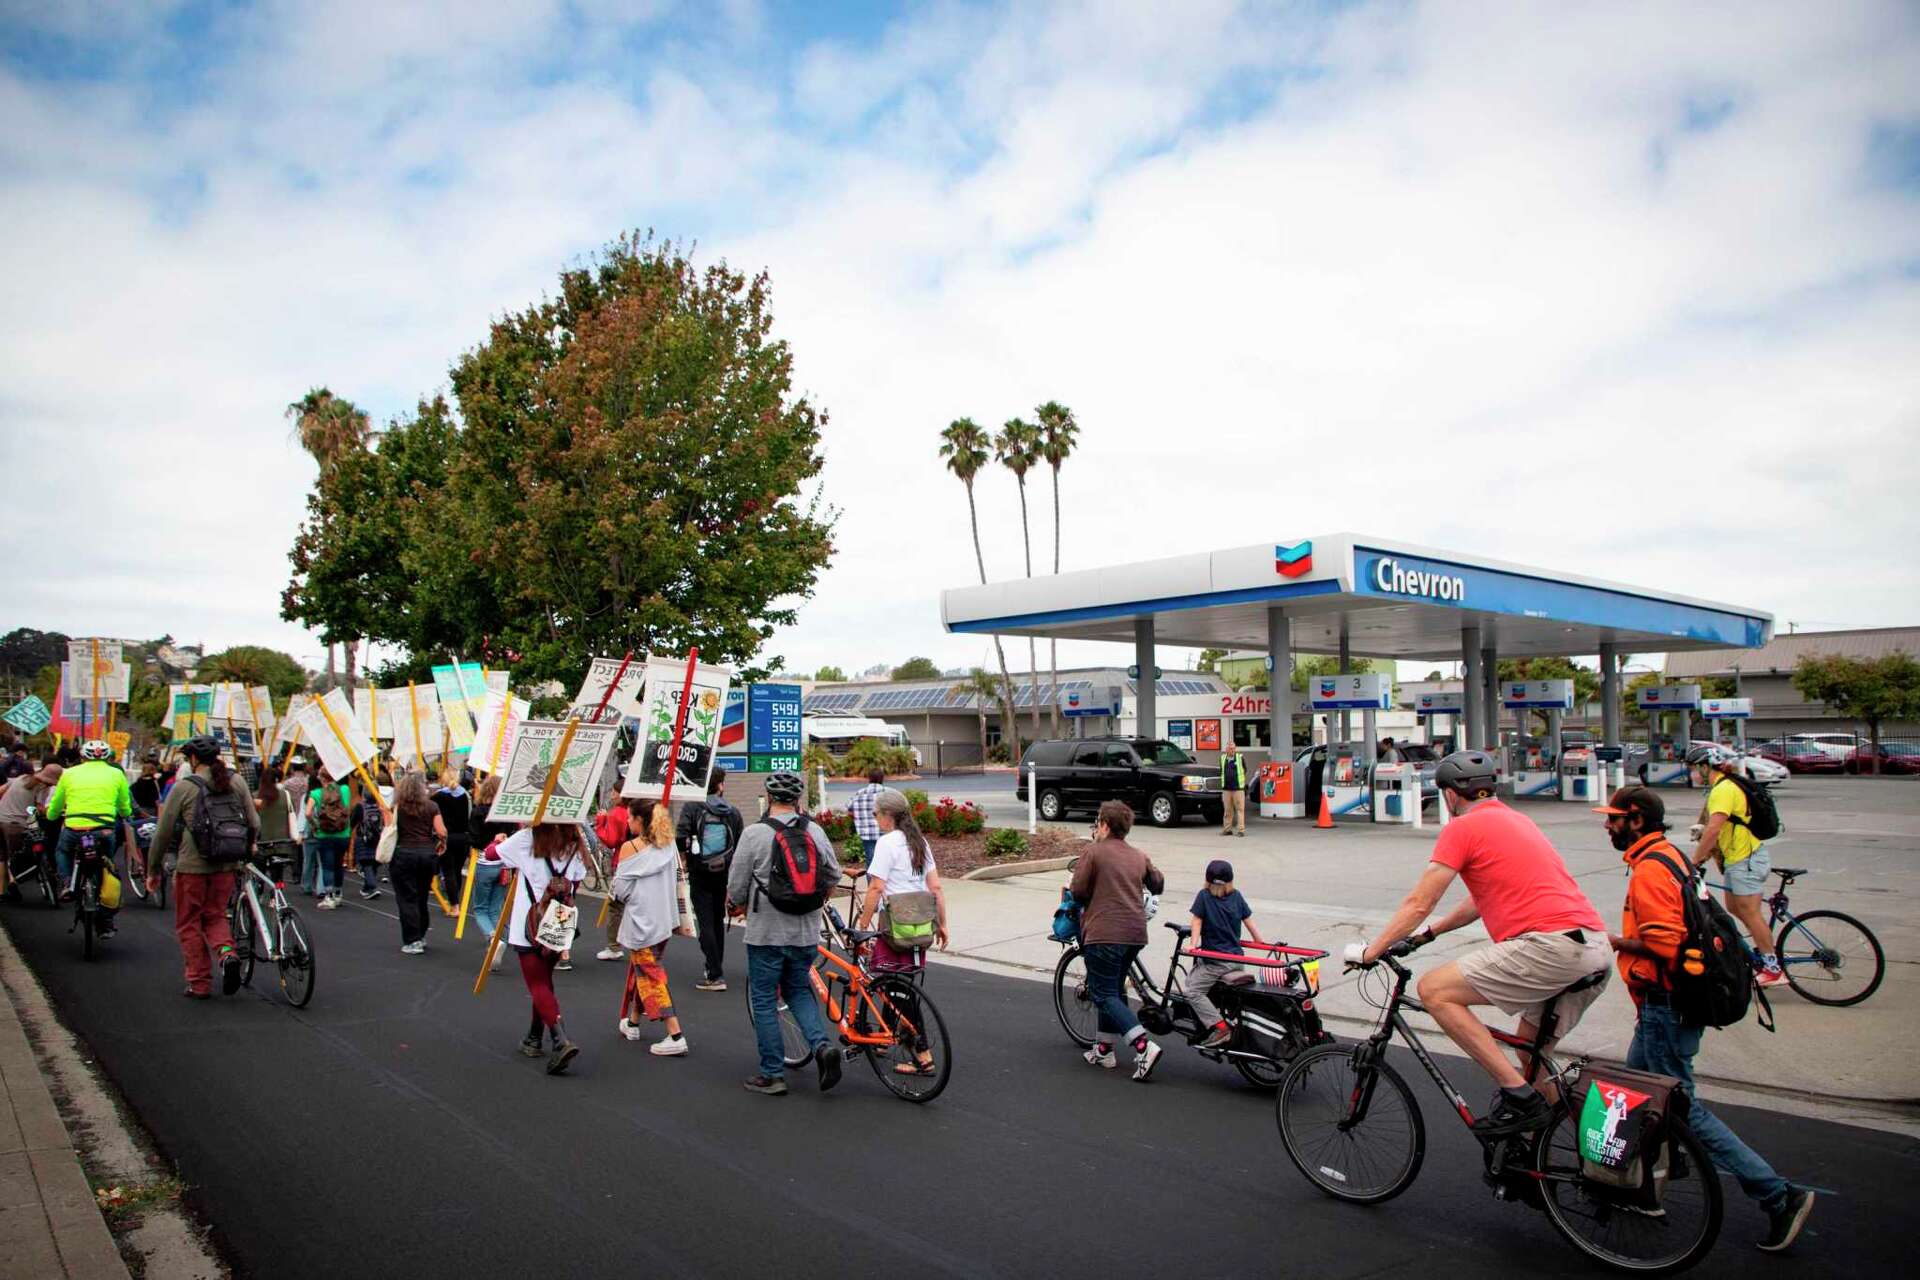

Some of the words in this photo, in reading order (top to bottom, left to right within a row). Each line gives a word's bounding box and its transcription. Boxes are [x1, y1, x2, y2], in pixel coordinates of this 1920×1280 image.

[1377, 556, 1464, 601] Chevron
[1353, 678, 1361, 690] 3
[1541, 683, 1549, 692] 5
[1672, 689, 1680, 697] 7
[1222, 697, 1272, 713] 24hrs
[1586, 1137, 1624, 1160] PALESTINE
[1612, 1137, 1627, 1149] FOR
